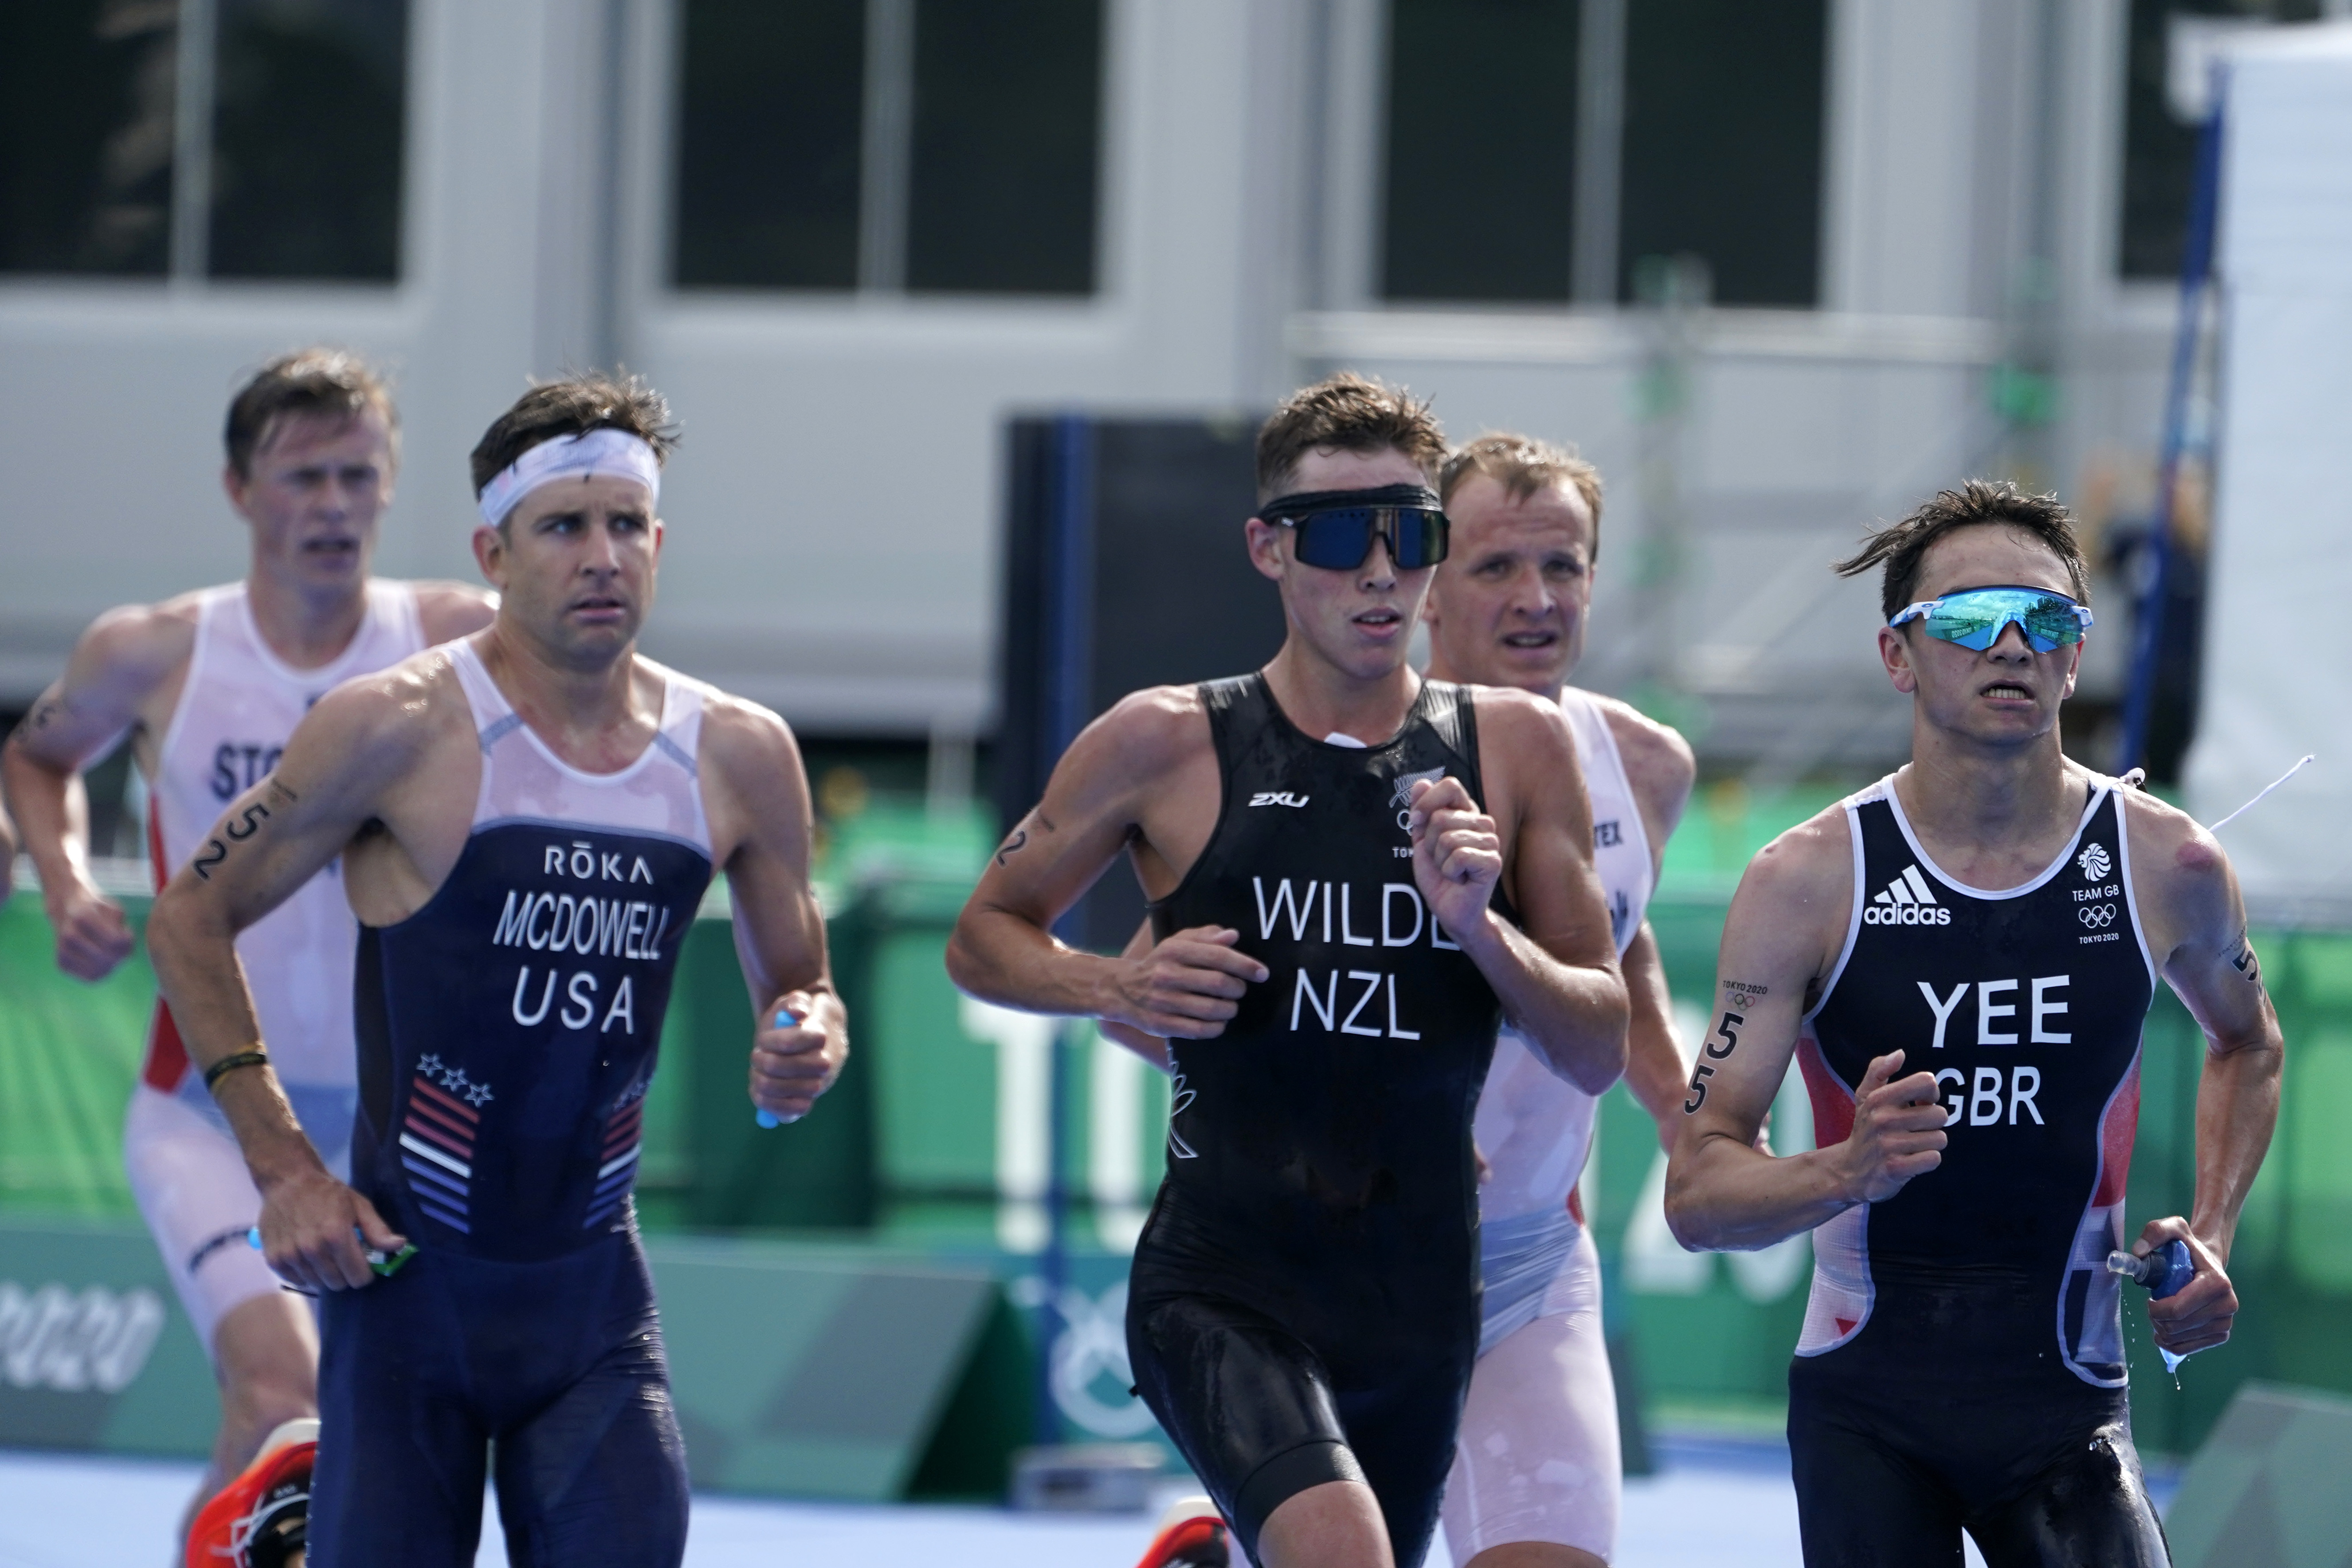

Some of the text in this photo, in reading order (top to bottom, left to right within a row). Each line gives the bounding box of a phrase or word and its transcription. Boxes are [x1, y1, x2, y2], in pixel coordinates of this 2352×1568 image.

[1248, 792, 1309, 808] 2XU
[1863, 902, 1951, 925] adidas
[2072, 884, 2119, 902] TEAM GB
[493, 888, 670, 960] MCDOWELL
[2079, 932, 2119, 945] TOKYO 2020
[512, 964, 635, 1035] USA
[1289, 967, 1421, 1041] NZL
[1722, 980, 1768, 995] TOKYO 2020
[1916, 974, 2072, 1048] YEE
[1934, 1066, 2045, 1127] GBR
